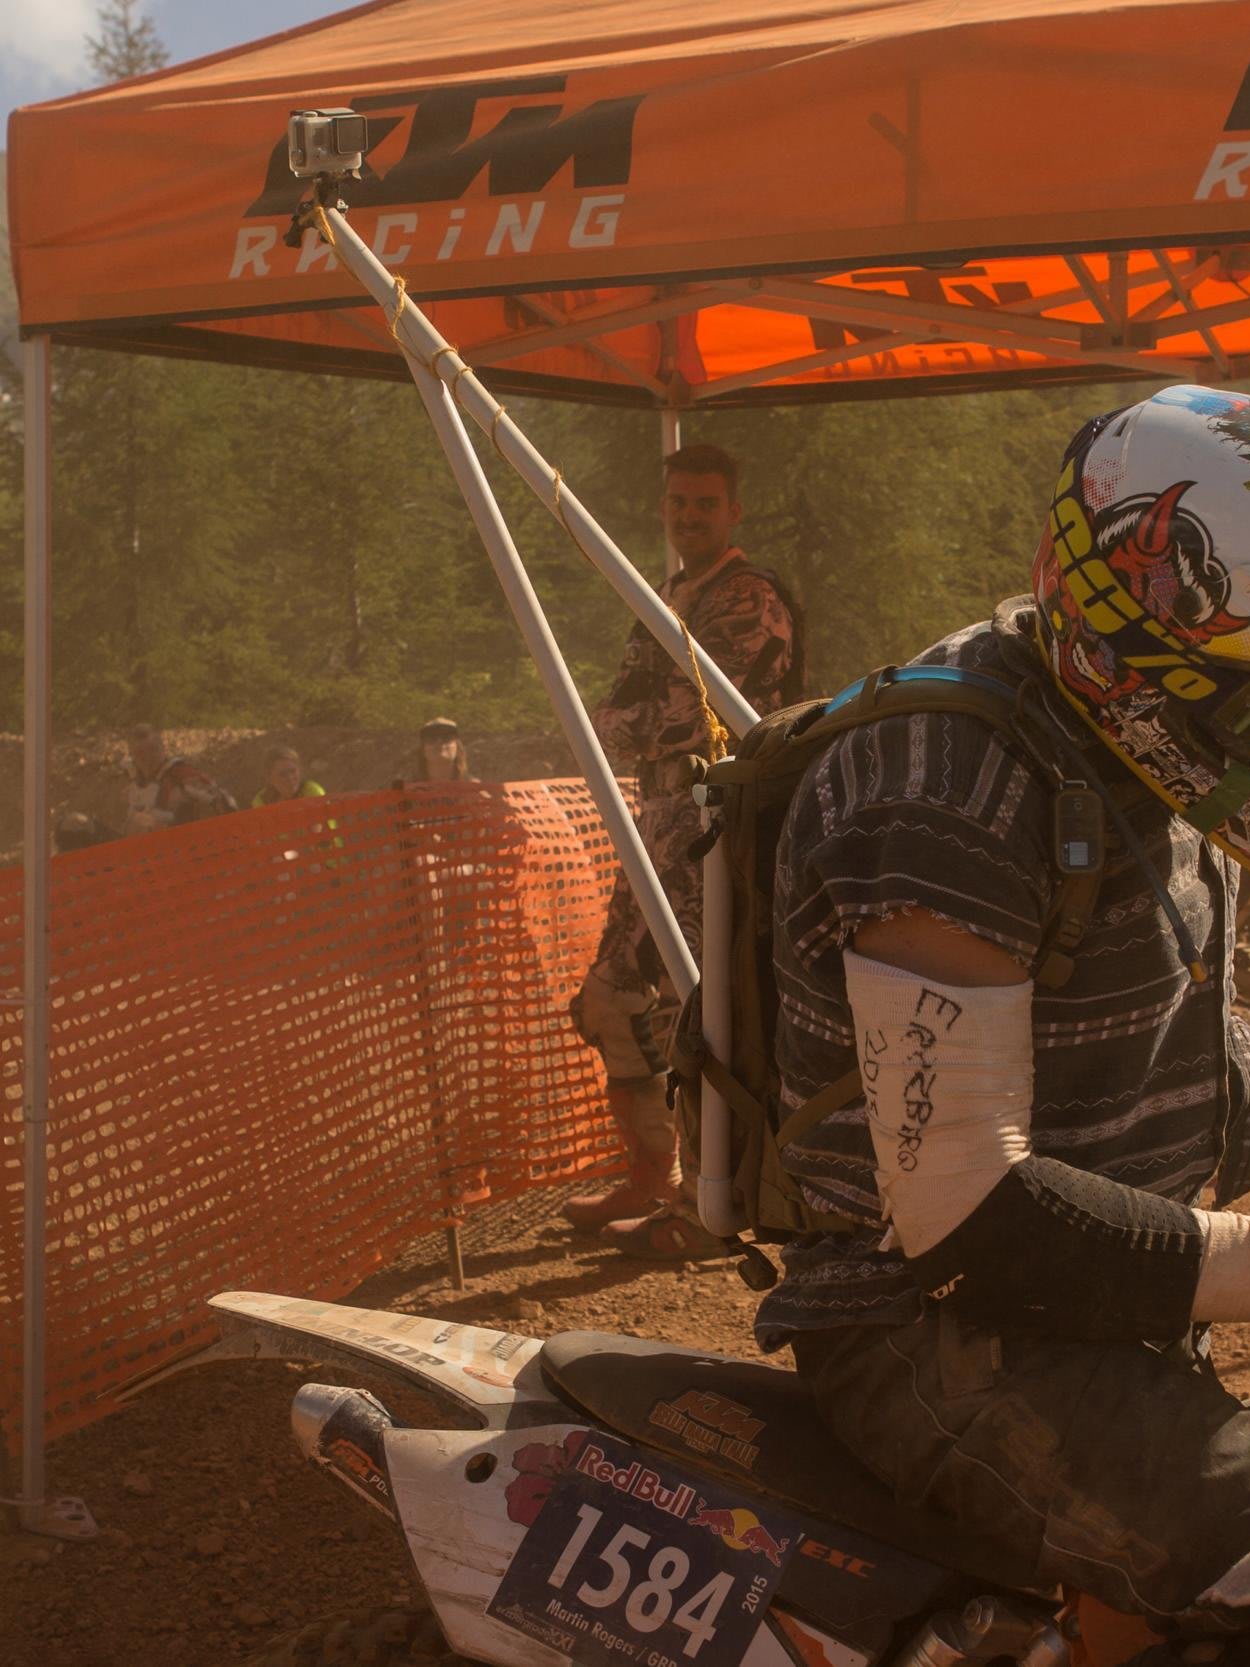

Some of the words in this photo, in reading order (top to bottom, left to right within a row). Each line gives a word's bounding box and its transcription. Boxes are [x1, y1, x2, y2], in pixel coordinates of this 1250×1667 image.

[547, 1503, 737, 1659] 1584
[799, 1538, 877, 1579] EXC
[740, 1574, 769, 1615] 2015
[545, 1599, 590, 1631] Martin
[591, 1621, 634, 1656] Rogers
